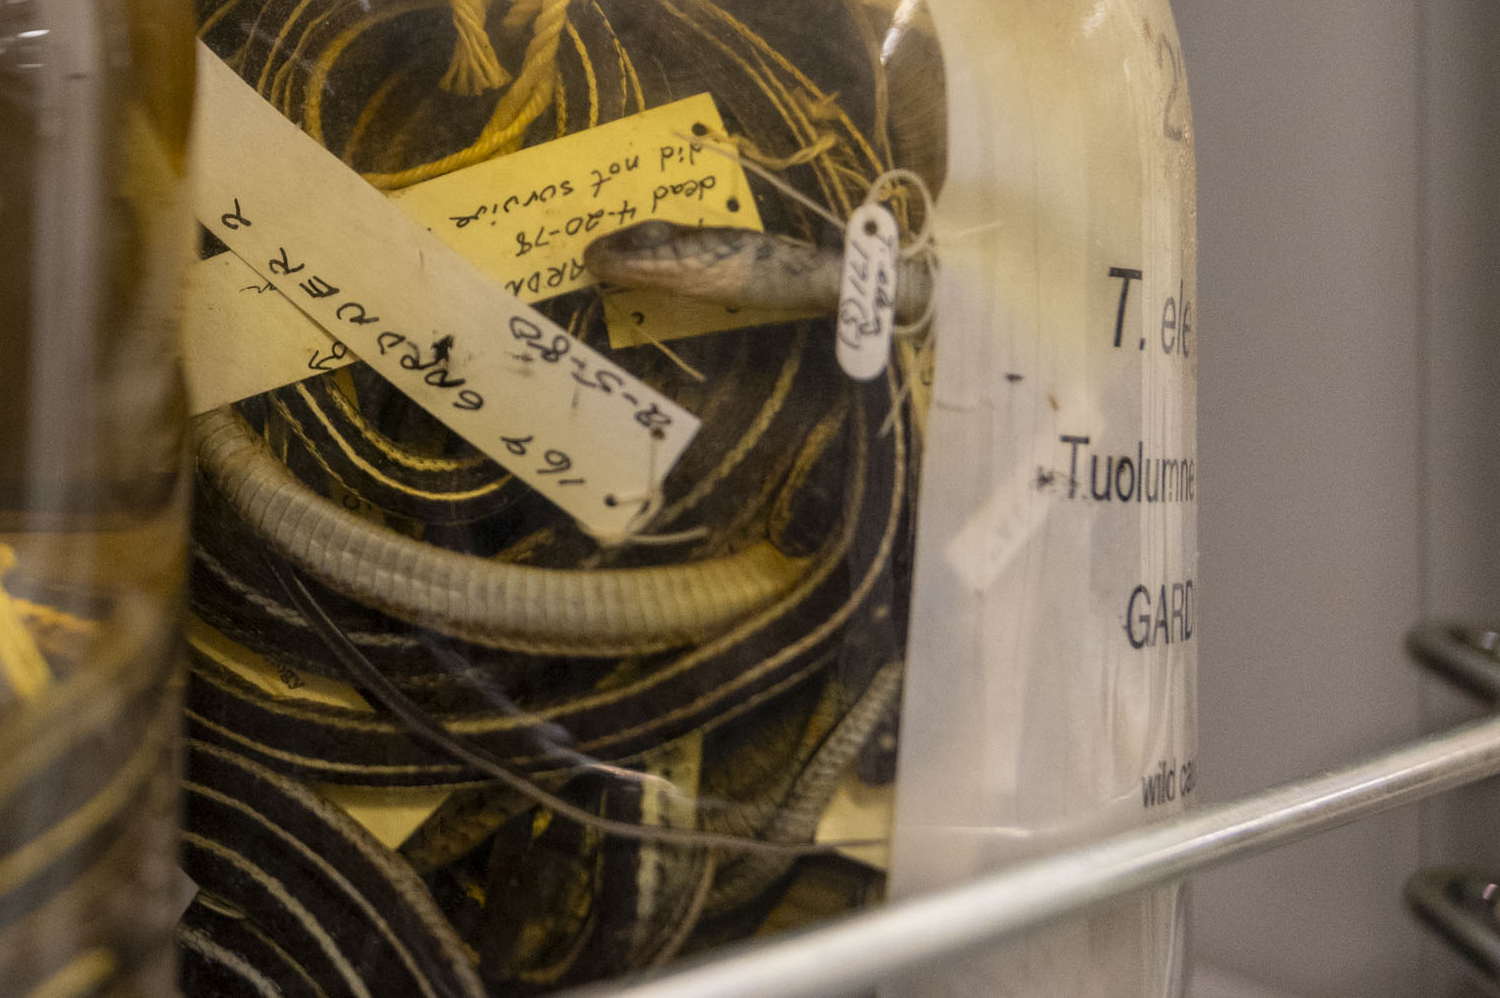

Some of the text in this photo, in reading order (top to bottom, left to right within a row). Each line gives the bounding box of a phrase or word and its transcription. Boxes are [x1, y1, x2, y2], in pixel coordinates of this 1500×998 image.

[590, 154, 640, 199] not
[660, 141, 703, 173] did
[514, 174, 717, 258] dead 4-20-78
[268, 247, 485, 412] GARDNER
[1108, 266, 1146, 351] T.
[499, 434, 587, 486] 169
[1059, 434, 1195, 503] Tuolumne
[1126, 578, 1194, 650] GARD
[1141, 757, 1176, 808] wild
